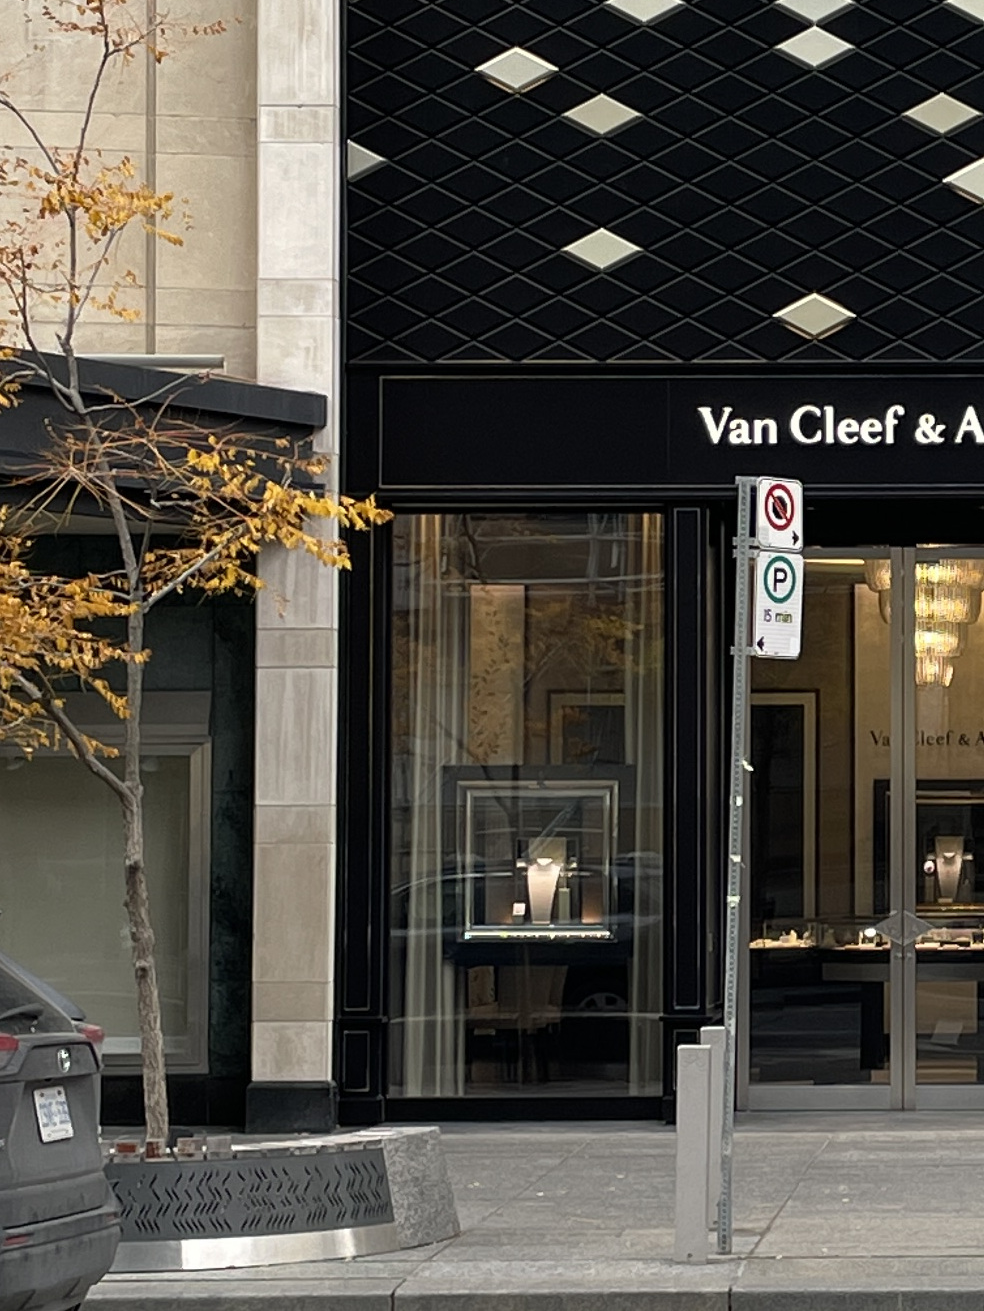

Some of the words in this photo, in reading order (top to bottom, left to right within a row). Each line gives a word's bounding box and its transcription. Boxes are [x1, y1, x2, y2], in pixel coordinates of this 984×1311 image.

[697, 406, 778, 445] Van
[789, 404, 905, 445] Cleef
[914, 412, 946, 444] &
[773, 567, 787, 592] P
[870, 730, 891, 746] Va
[957, 732, 971, 747] &
